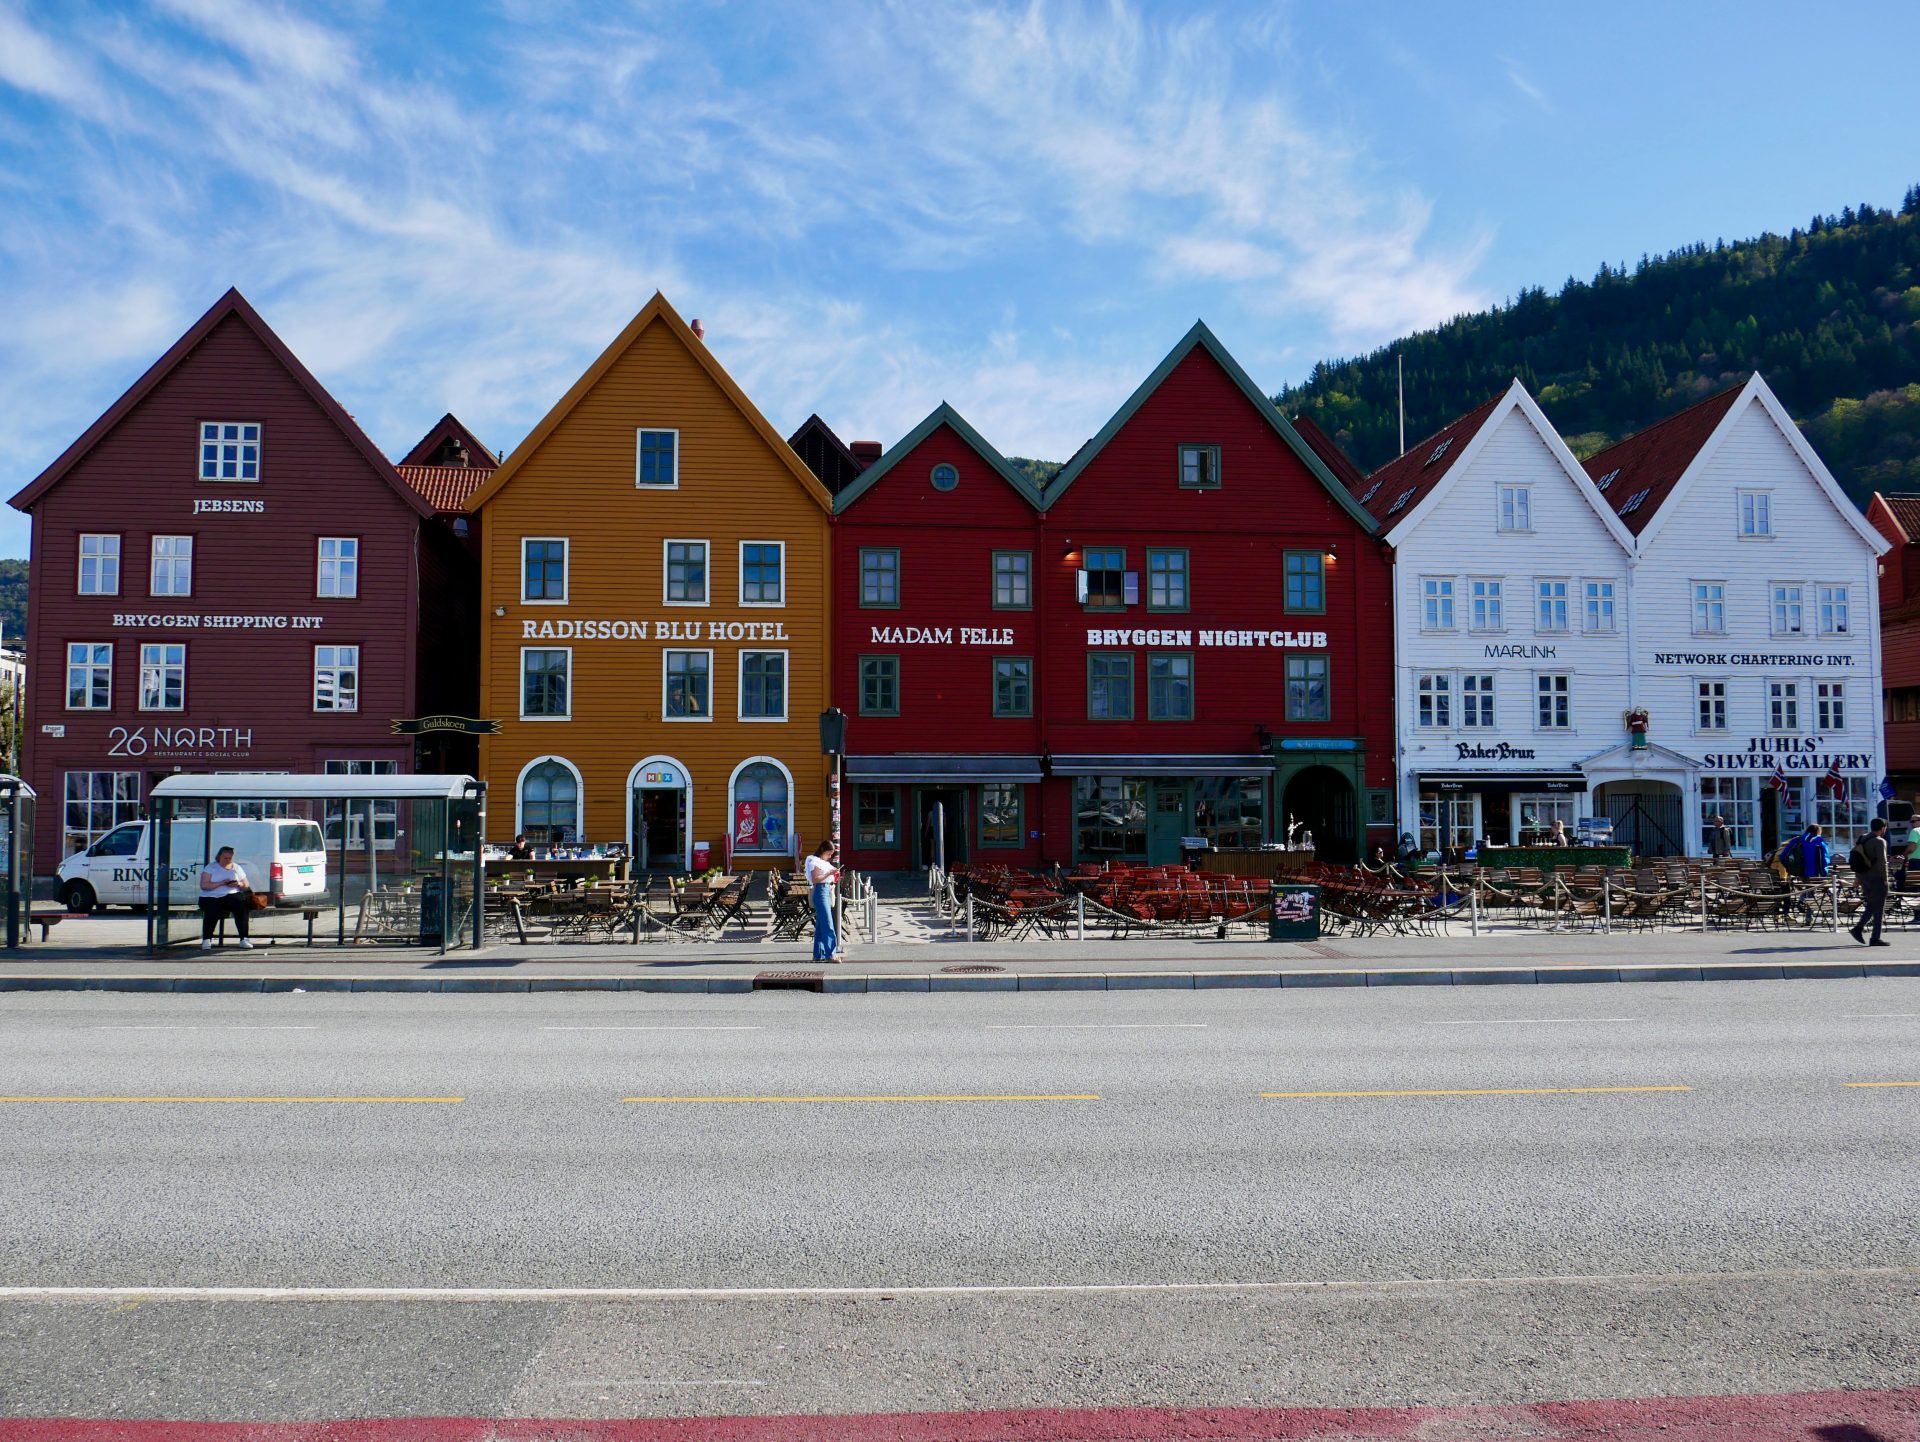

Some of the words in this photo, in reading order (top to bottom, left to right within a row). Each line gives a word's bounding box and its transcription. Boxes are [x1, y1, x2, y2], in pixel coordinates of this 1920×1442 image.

[193, 499, 265, 514] JEBSENS
[112, 614, 200, 628] BRYGGEN
[203, 615, 288, 628] SHIPPING
[291, 616, 323, 629] INT
[522, 620, 648, 640] RADISSON
[654, 621, 703, 640] BLU
[708, 622, 789, 641] HOTEL
[870, 626, 953, 644] MADAM
[960, 627, 1014, 645] FELLE
[1086, 629, 1192, 646] BRYGGEN
[1198, 630, 1328, 648] NIGHTCLUB
[1484, 644, 1556, 659] MARLINK
[1654, 653, 1727, 665] NETWORK
[1730, 654, 1824, 666] CHARTERING
[1827, 655, 1855, 666] INT.
[423, 718, 465, 729] Guldskoen
[107, 726, 148, 756] 26
[154, 727, 252, 749] NORTH
[1704, 753, 1776, 769] SILVER
[1785, 754, 1872, 769] GALLERY
[647, 772, 672, 783] MIX
[113, 868, 189, 881] RINES
